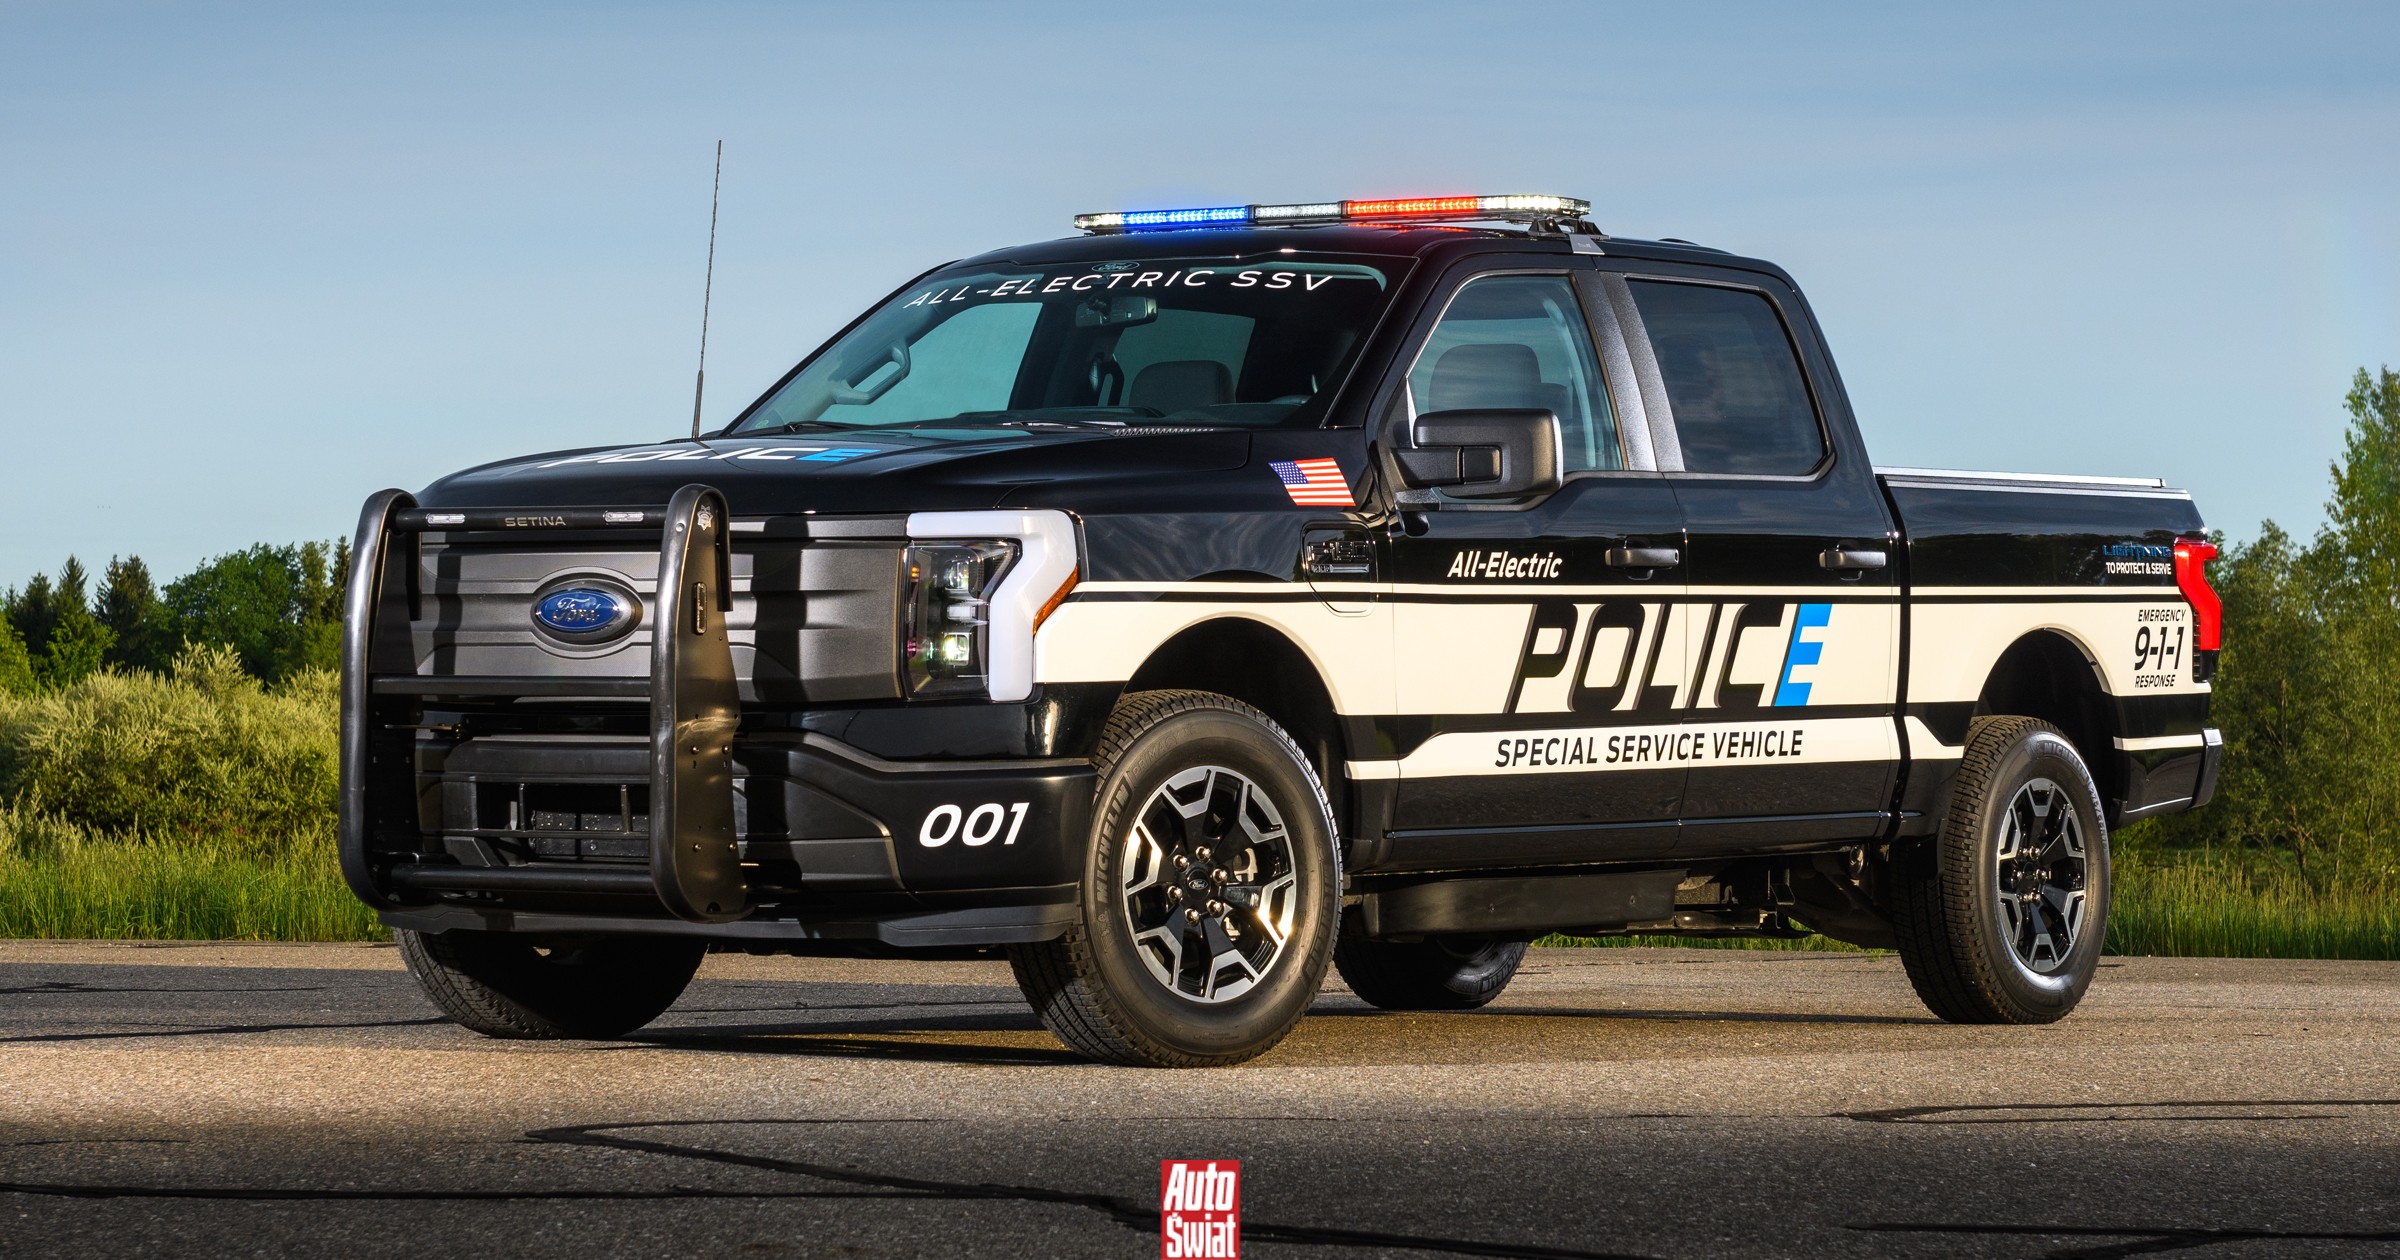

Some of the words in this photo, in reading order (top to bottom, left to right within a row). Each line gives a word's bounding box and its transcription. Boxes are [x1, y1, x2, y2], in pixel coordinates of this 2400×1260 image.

[903, 270, 1217, 309] ALL-ELECTRIC
[1230, 270, 1333, 291] SSV
[537, 447, 881, 469] POLICE
[504, 516, 567, 527] SETINA
[1447, 551, 1563, 578] All-Electric
[2102, 544, 2172, 559] LIGHTNING
[2106, 562, 2116, 574] TO
[2116, 562, 2145, 575] PROTECT
[2145, 563, 2151, 575] &
[2151, 563, 2172, 575] SERVE
[2138, 609, 2187, 622] EMERGENCY
[1502, 603, 1833, 713] POLICE
[2134, 626, 2185, 671] 9-1-1
[2135, 675, 2176, 688] RESPONSE
[1495, 736, 1598, 768] SPECIAL
[1605, 732, 1705, 764] SERVICE
[1713, 729, 1803, 758] VEHICLE
[919, 802, 1030, 848] 001
[1096, 781, 1132, 903] MICHELIN
